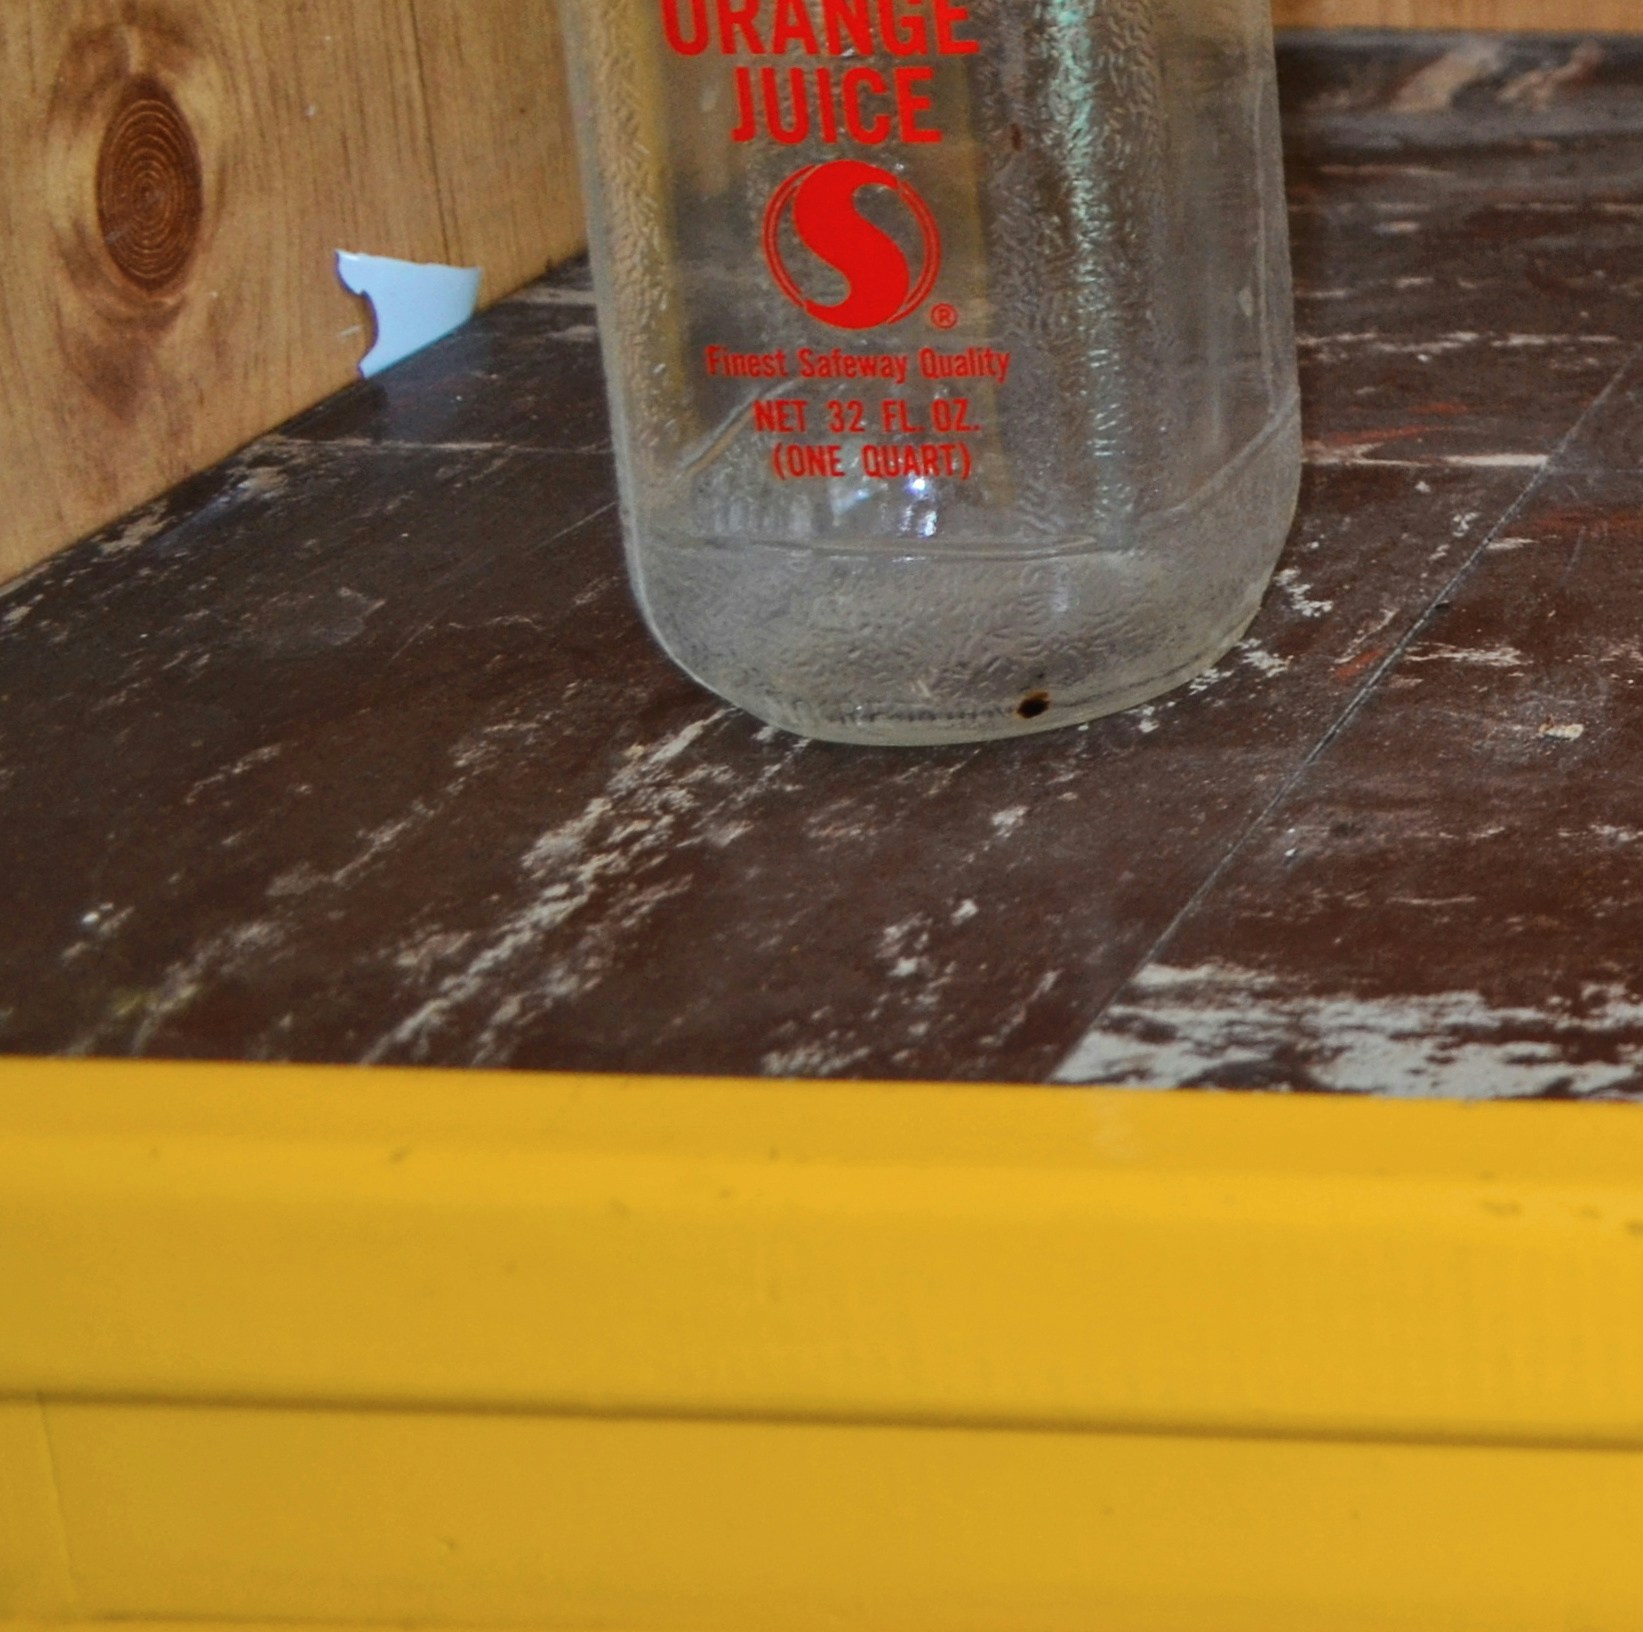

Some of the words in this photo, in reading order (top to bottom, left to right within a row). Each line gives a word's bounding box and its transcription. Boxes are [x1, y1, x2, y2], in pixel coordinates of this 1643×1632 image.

[730, 65, 943, 146] JUICE
[706, 345, 787, 379] Finest
[797, 347, 909, 384] Safeway
[918, 347, 1011, 382] Quality
[753, 399, 807, 433] NET
[827, 400, 865, 433] 32
[881, 399, 924, 433] FL.
[931, 398, 982, 433] OZ.
[772, 444, 846, 480] (ONE
[861, 443, 973, 481] QUART)
